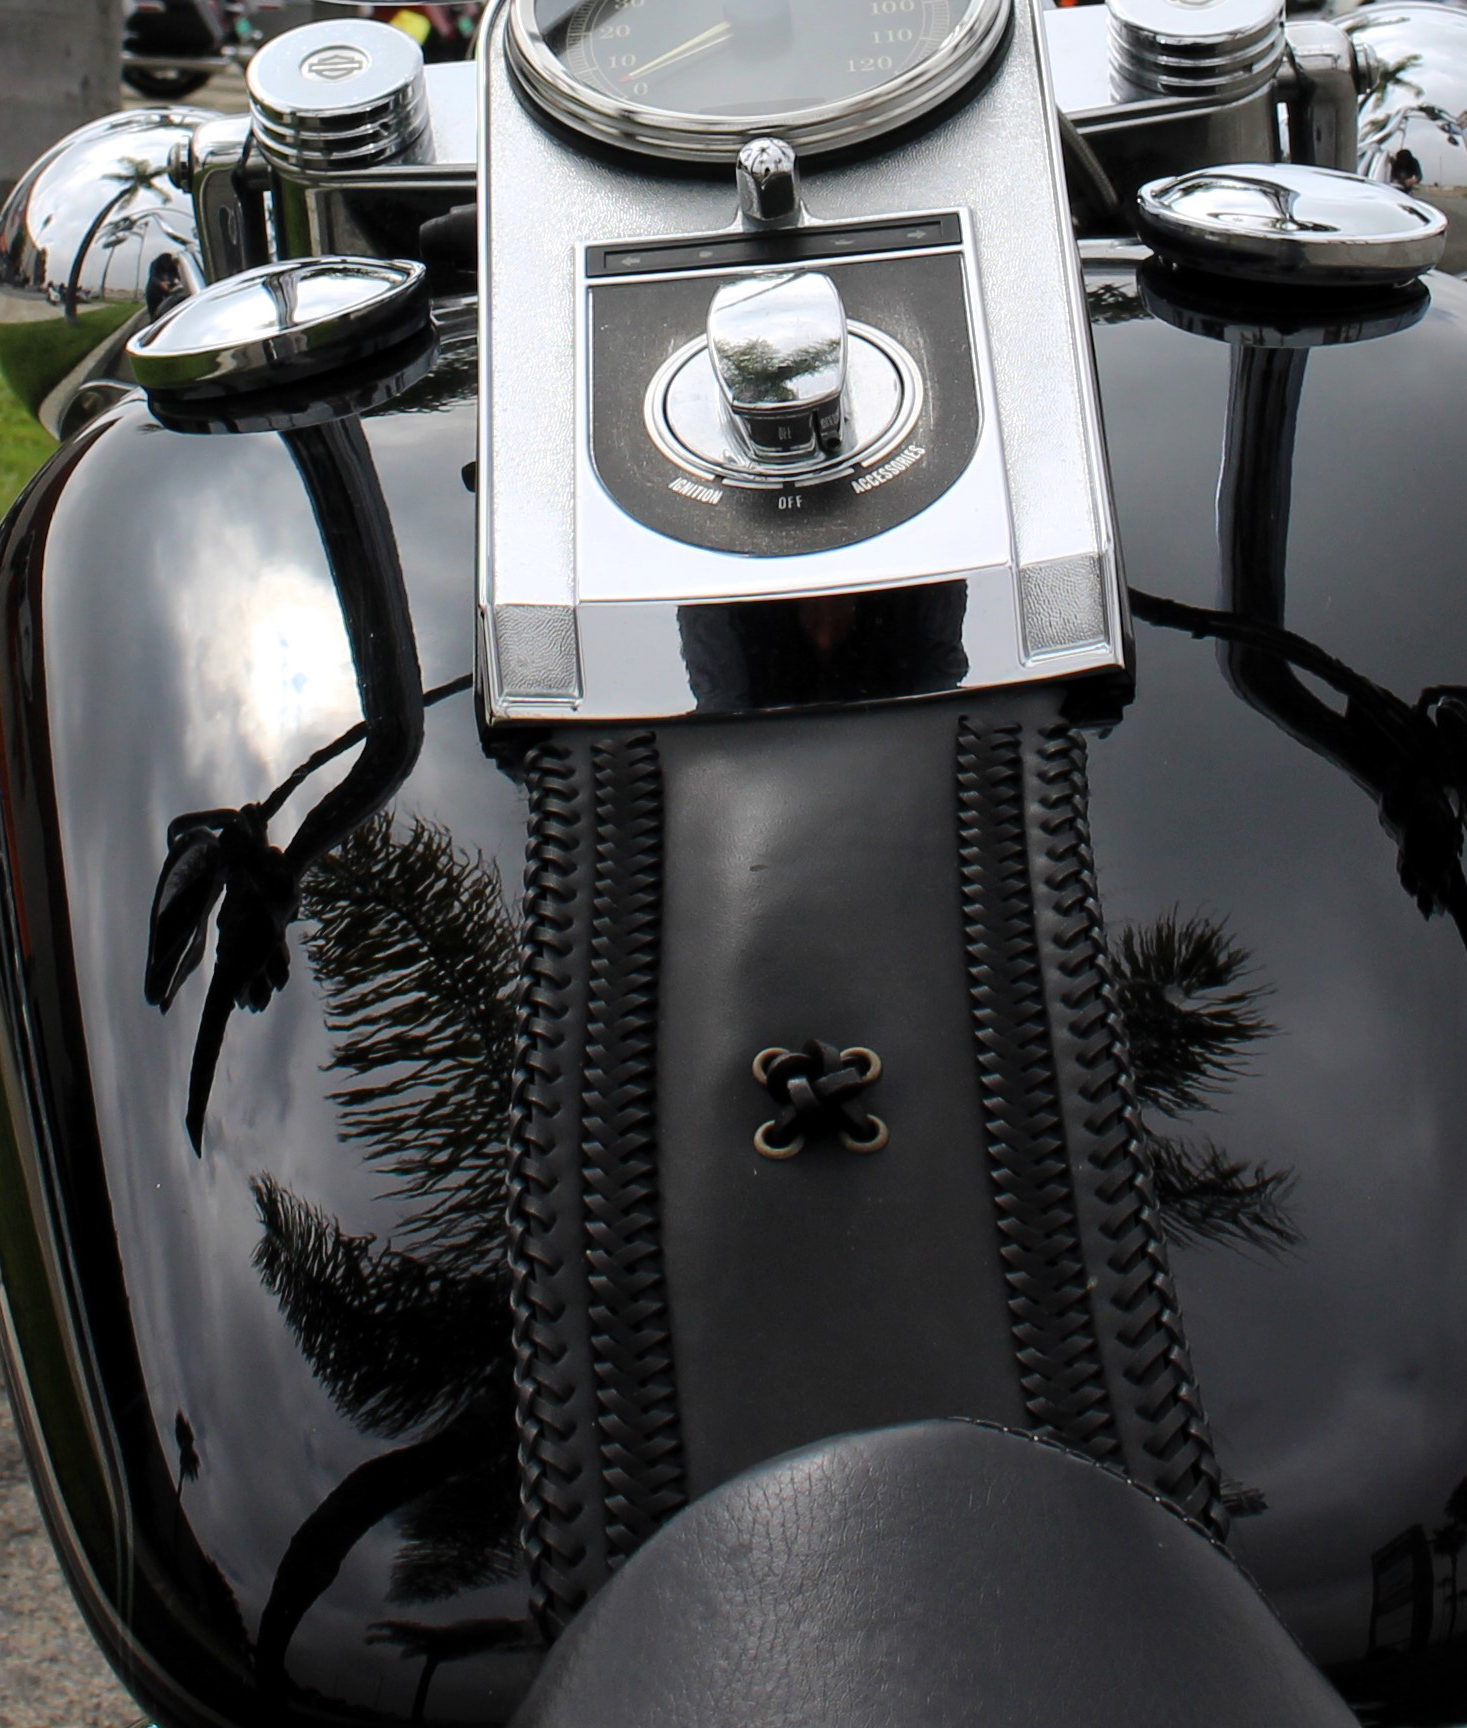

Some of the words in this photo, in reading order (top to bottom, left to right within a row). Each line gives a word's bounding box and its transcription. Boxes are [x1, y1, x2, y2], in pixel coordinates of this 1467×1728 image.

[599, 23, 631, 40] 20
[870, 27, 914, 45] 110
[608, 53, 637, 70] 10
[846, 55, 894, 73] 120
[633, 81, 649, 96] 0
[850, 443, 927, 495] ACCESSORIES
[666, 475, 724, 505] IGNITION
[777, 494, 804, 510] OFF
